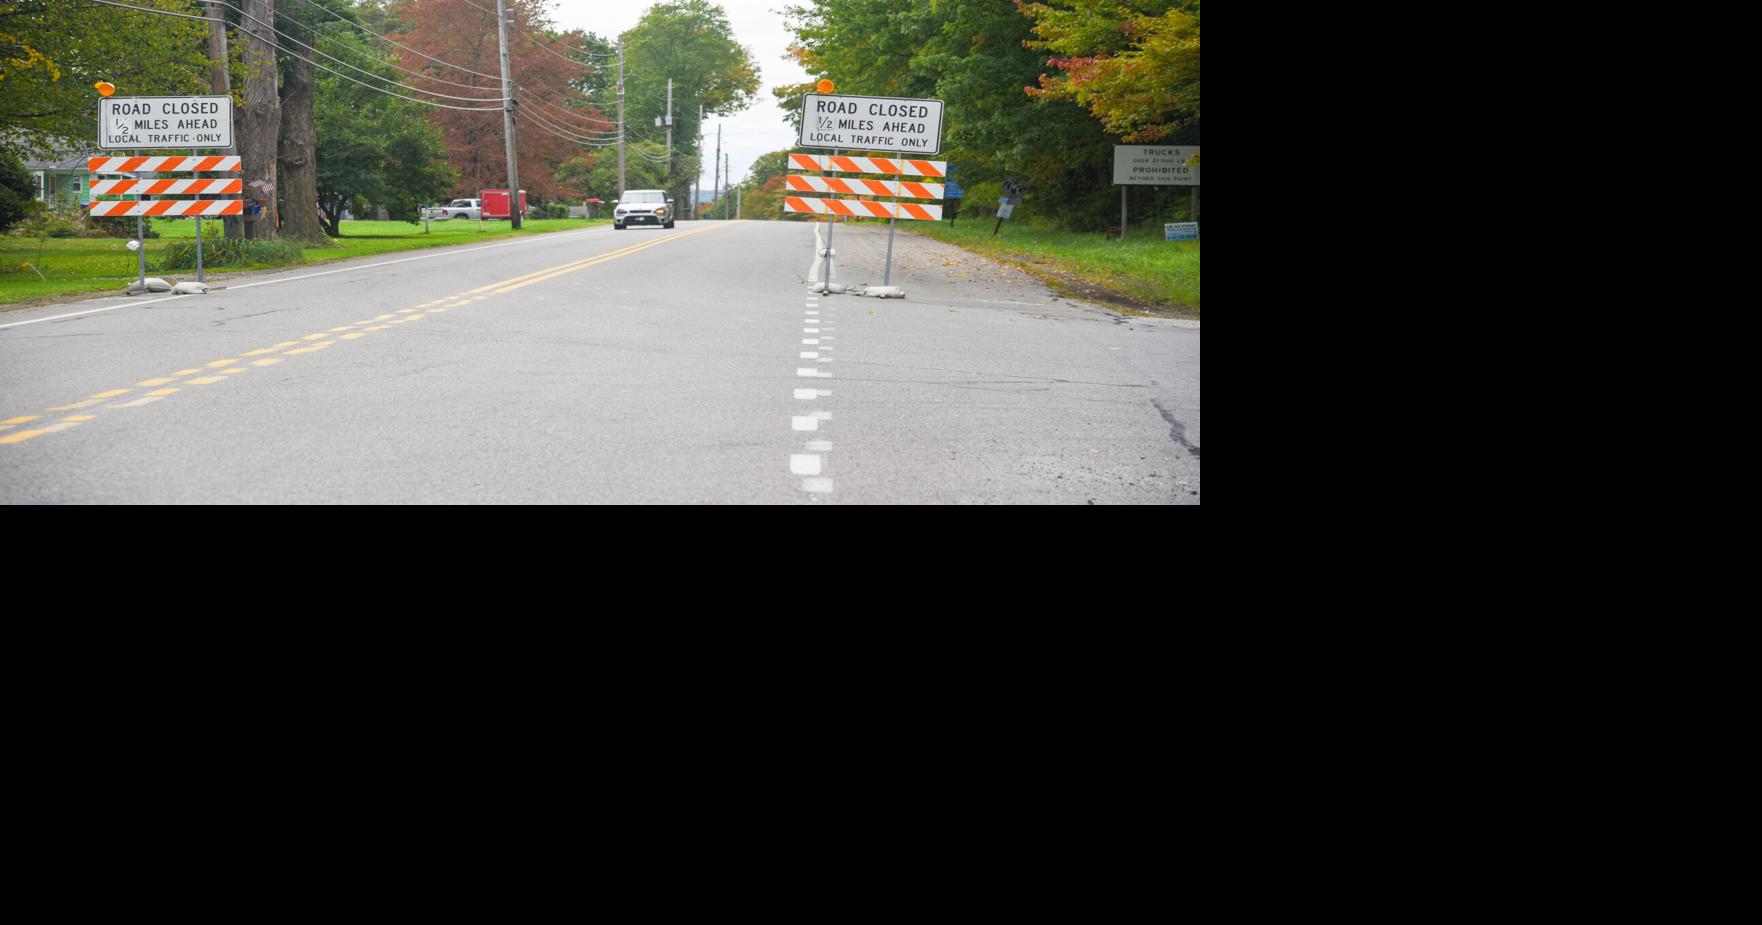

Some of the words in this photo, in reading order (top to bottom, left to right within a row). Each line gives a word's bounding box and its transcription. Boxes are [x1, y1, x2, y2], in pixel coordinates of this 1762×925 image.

[112, 103, 151, 115] ROAD
[162, 102, 218, 115] CLOSED
[817, 100, 858, 115] ROAD
[869, 103, 928, 118] CLOSED
[134, 119, 169, 130] MILES
[177, 119, 218, 129] AHEAD
[838, 119, 874, 131] MILES
[882, 121, 926, 134] AHEAD
[108, 135, 142, 143] LOCAL
[148, 134, 190, 143] TRAFFIC
[196, 133, 222, 142] ONLY
[810, 132, 844, 143] LOCAL
[851, 134, 894, 146] TRAFFIC
[901, 137, 929, 148] ONLY
